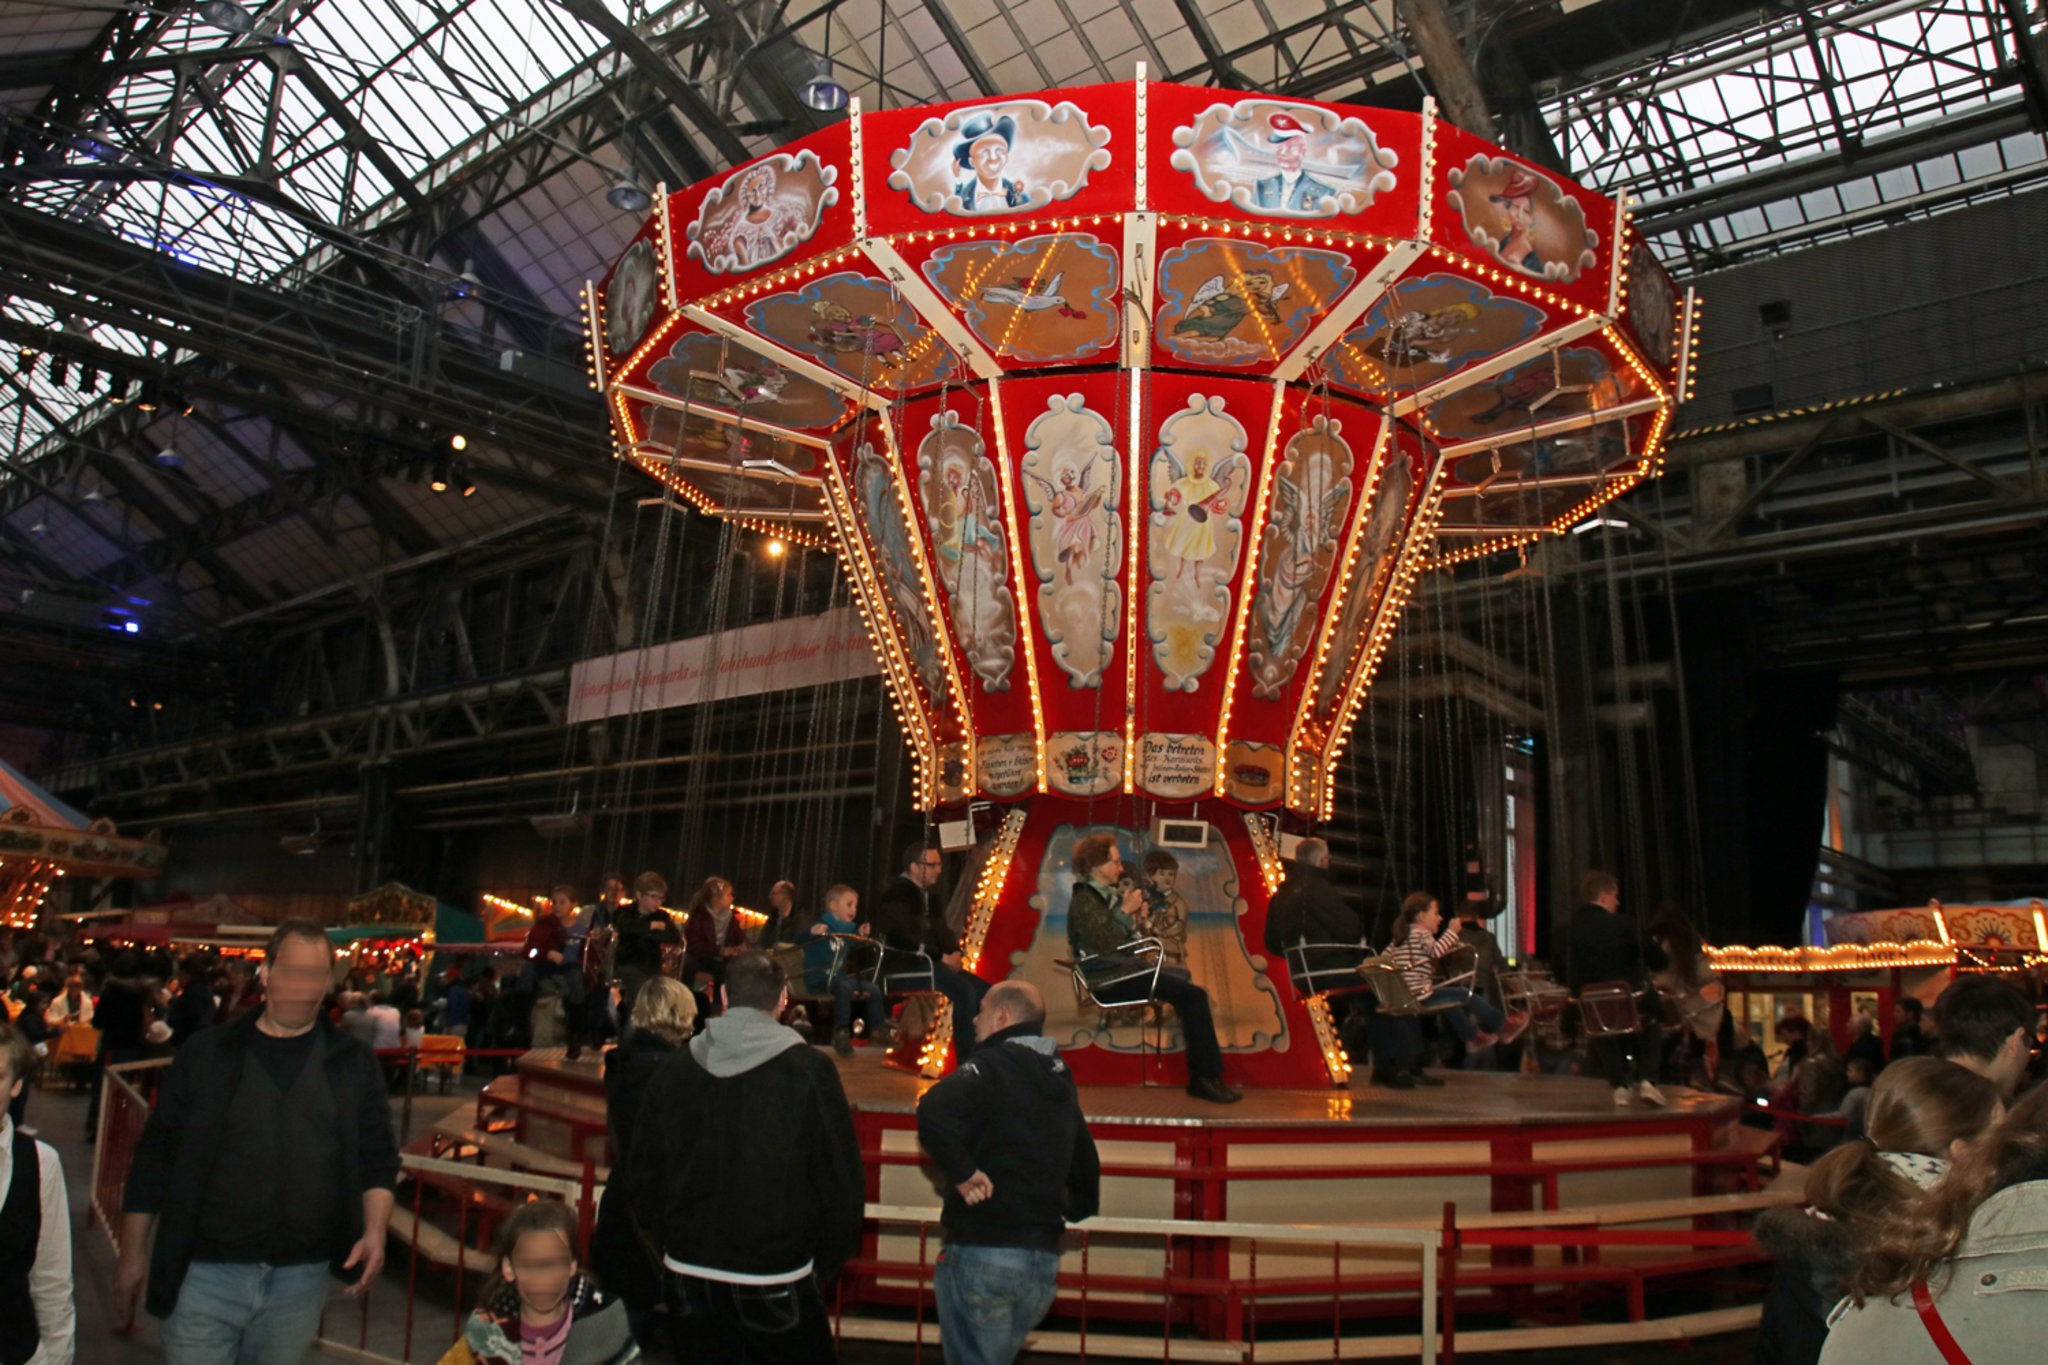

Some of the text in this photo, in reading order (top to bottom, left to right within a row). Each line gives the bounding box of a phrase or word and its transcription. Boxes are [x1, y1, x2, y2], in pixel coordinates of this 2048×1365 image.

[1144, 740, 1164, 753] Das
[1147, 772, 1200, 785] ist verboten
[1855, 951, 1908, 961] HAGEN
